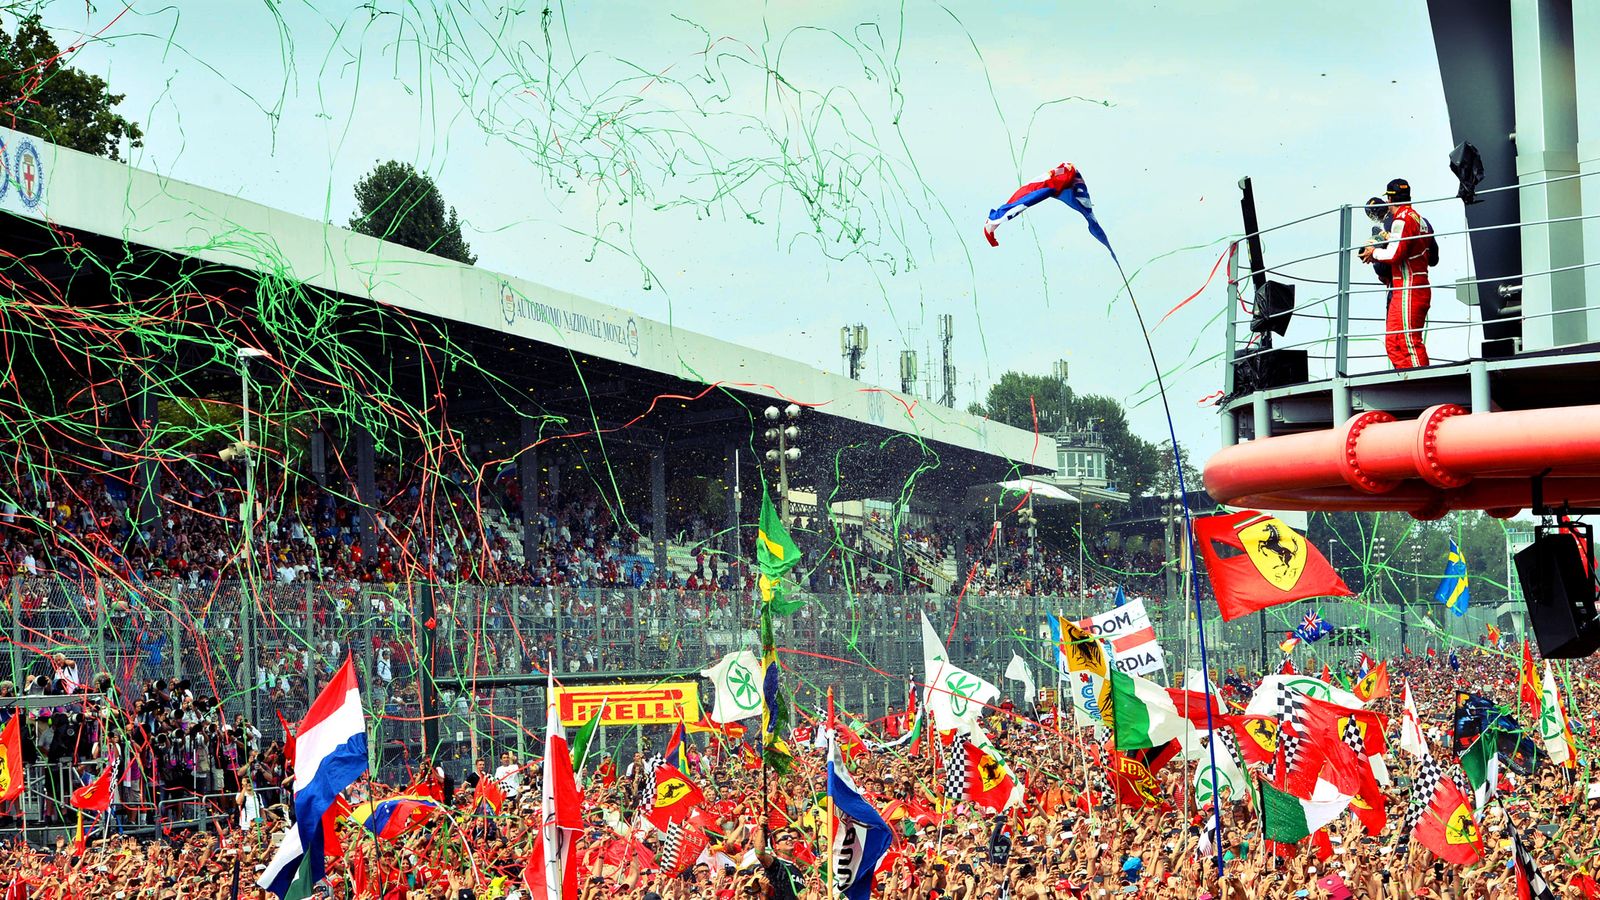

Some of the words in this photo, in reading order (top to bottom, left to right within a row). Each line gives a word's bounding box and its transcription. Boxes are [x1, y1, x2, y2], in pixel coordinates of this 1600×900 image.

[517, 299, 561, 328] AUTODROMO
[563, 310, 602, 339] NAZIONALE
[602, 321, 627, 345] MONZA
[1089, 611, 1131, 635] DOM
[1115, 651, 1157, 672] RDIA
[559, 689, 684, 721] PIRELLI
